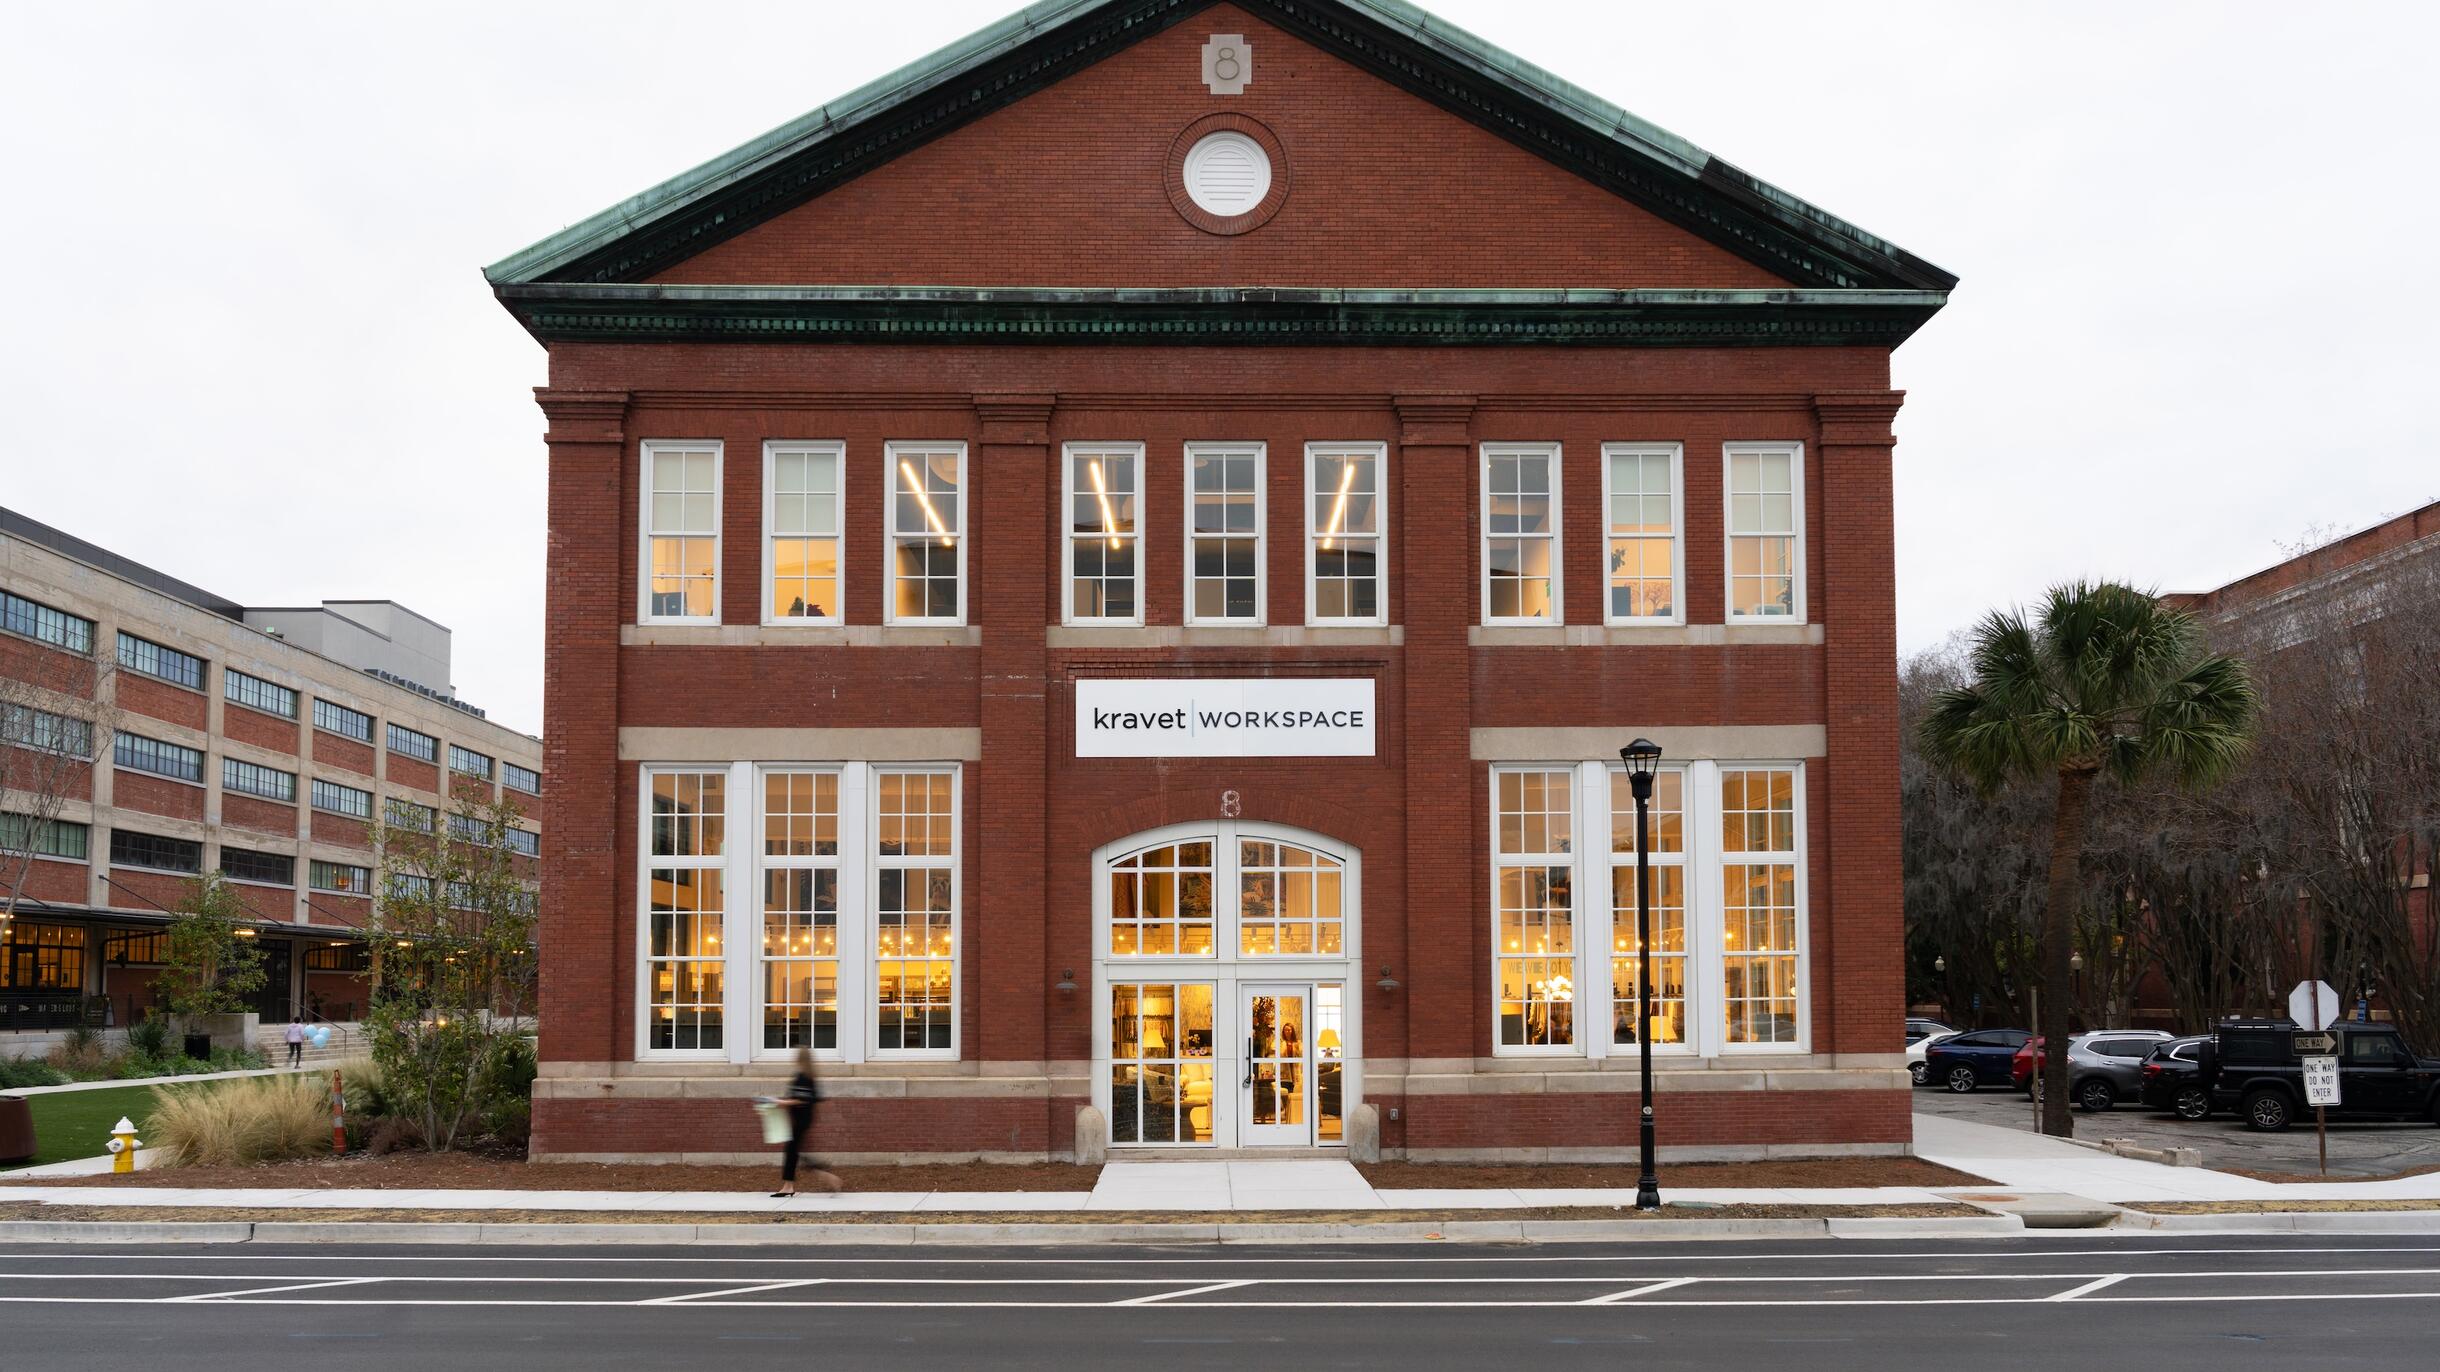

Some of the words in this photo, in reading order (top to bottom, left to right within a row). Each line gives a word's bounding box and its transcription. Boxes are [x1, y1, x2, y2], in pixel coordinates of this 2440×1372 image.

[1214, 47, 1240, 80] 8
[1093, 707, 1187, 730] kravet
[1198, 710, 1365, 728] WORKSPACE
[2296, 1038, 2310, 1048] ONE
[2311, 1038, 2324, 1048] WAY
[2305, 1063, 2318, 1073] ONE
[2321, 1063, 2336, 1073] WAY
[2308, 1075, 2318, 1086] DO
[2321, 1075, 2334, 1085] NOT
[2312, 1087, 2332, 1098] ENTER
